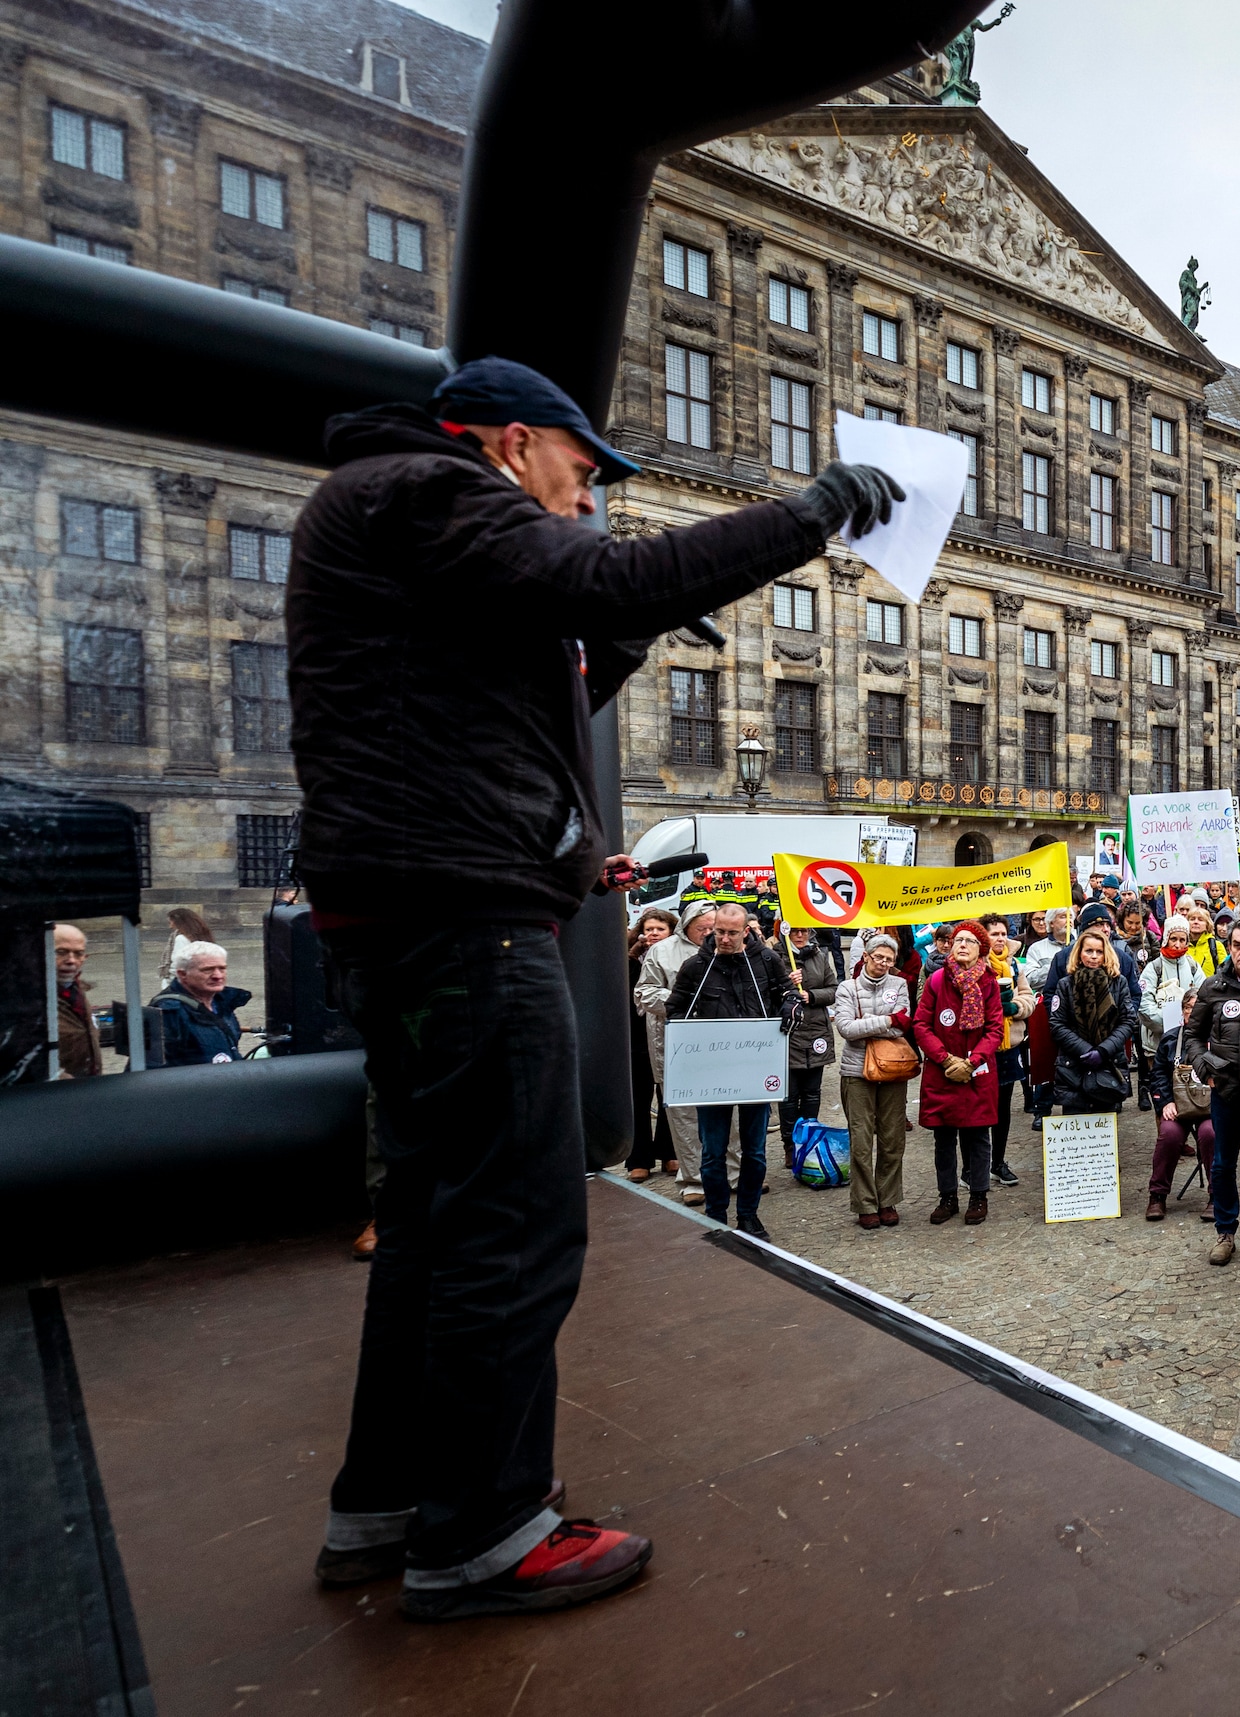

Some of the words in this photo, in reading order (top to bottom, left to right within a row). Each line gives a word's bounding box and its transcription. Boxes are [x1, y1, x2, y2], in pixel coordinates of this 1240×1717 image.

[1142, 805, 1159, 816] GA
[1164, 803, 1192, 813] VOOR
[1197, 800, 1219, 812] een
[1147, 857, 1171, 872] 5G
[901, 886, 918, 895] 5G
[921, 885, 930, 894] is
[933, 883, 954, 893] niet
[957, 873, 999, 890] bewezen
[1001, 866, 1032, 879] veilig
[810, 879, 854, 906] 5G
[877, 899, 898, 911] Wij
[900, 896, 933, 908] willen
[936, 893, 963, 906] geen
[966, 885, 1031, 902] proefdieren
[1034, 881, 1053, 893] zijn
[708, 1041, 731, 1052] are
[766, 1080, 778, 1088] 5G
[671, 1088, 693, 1099] THIS
[700, 1088, 709, 1097] IS
